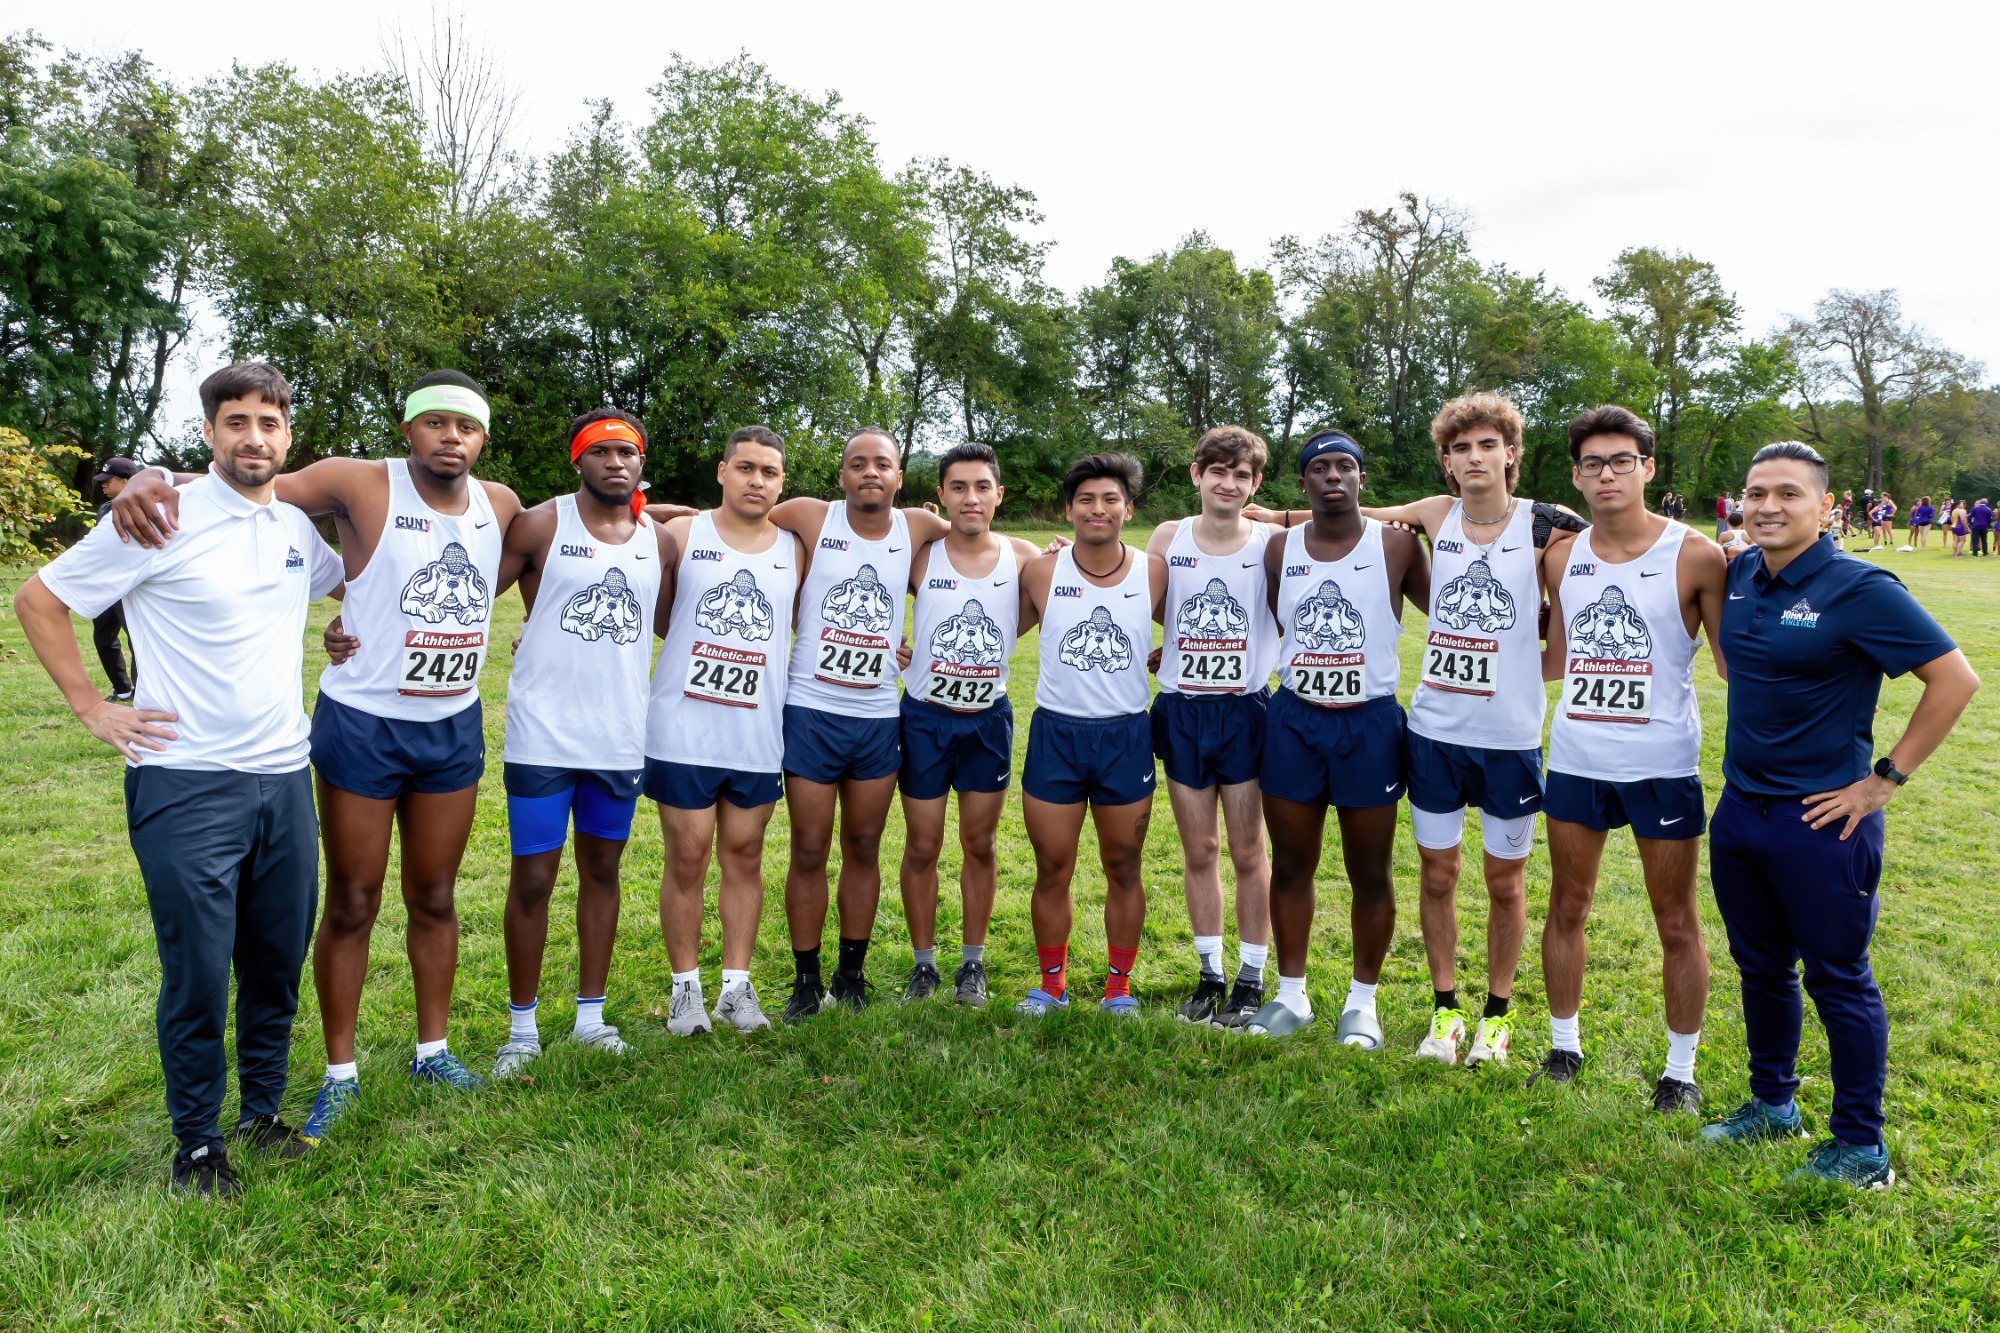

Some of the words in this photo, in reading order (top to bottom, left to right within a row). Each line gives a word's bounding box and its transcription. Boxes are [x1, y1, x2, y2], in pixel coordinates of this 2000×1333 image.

[395, 515, 433, 531] CUNY
[560, 544, 597, 557] CUNY
[821, 537, 851, 550] CUNY
[1437, 539, 1464, 553] CUNY
[691, 549, 725, 561] CUNY
[1170, 556, 1200, 567] CUNY
[1286, 564, 1313, 576] CUNY
[1570, 563, 1598, 575] CUNY
[929, 579, 959, 590] CUNY
[1054, 586, 1084, 597] CUNY
[1780, 618, 1817, 628] ATHLETICS
[1781, 610, 1803, 621] JOHN
[1803, 612, 1820, 622] JAY
[409, 632, 482, 647] Athletic.net
[823, 628, 887, 647] Athletic.net
[1180, 638, 1243, 650] Athletic.net
[1430, 632, 1495, 650] Athletic.net
[695, 643, 764, 664] Athletic.net
[1293, 653, 1362, 666] Athletic.net
[405, 651, 478, 683] 2429
[820, 644, 883, 678] 2424
[1181, 653, 1242, 680] 2423
[1429, 649, 1491, 684] 2431
[1571, 659, 1649, 673] Athletic.net
[933, 662, 998, 677] Athletic.net
[690, 660, 759, 696] 2428
[1295, 669, 1361, 697] 2426
[930, 676, 994, 703] 2432
[1571, 677, 1646, 710] 2425
